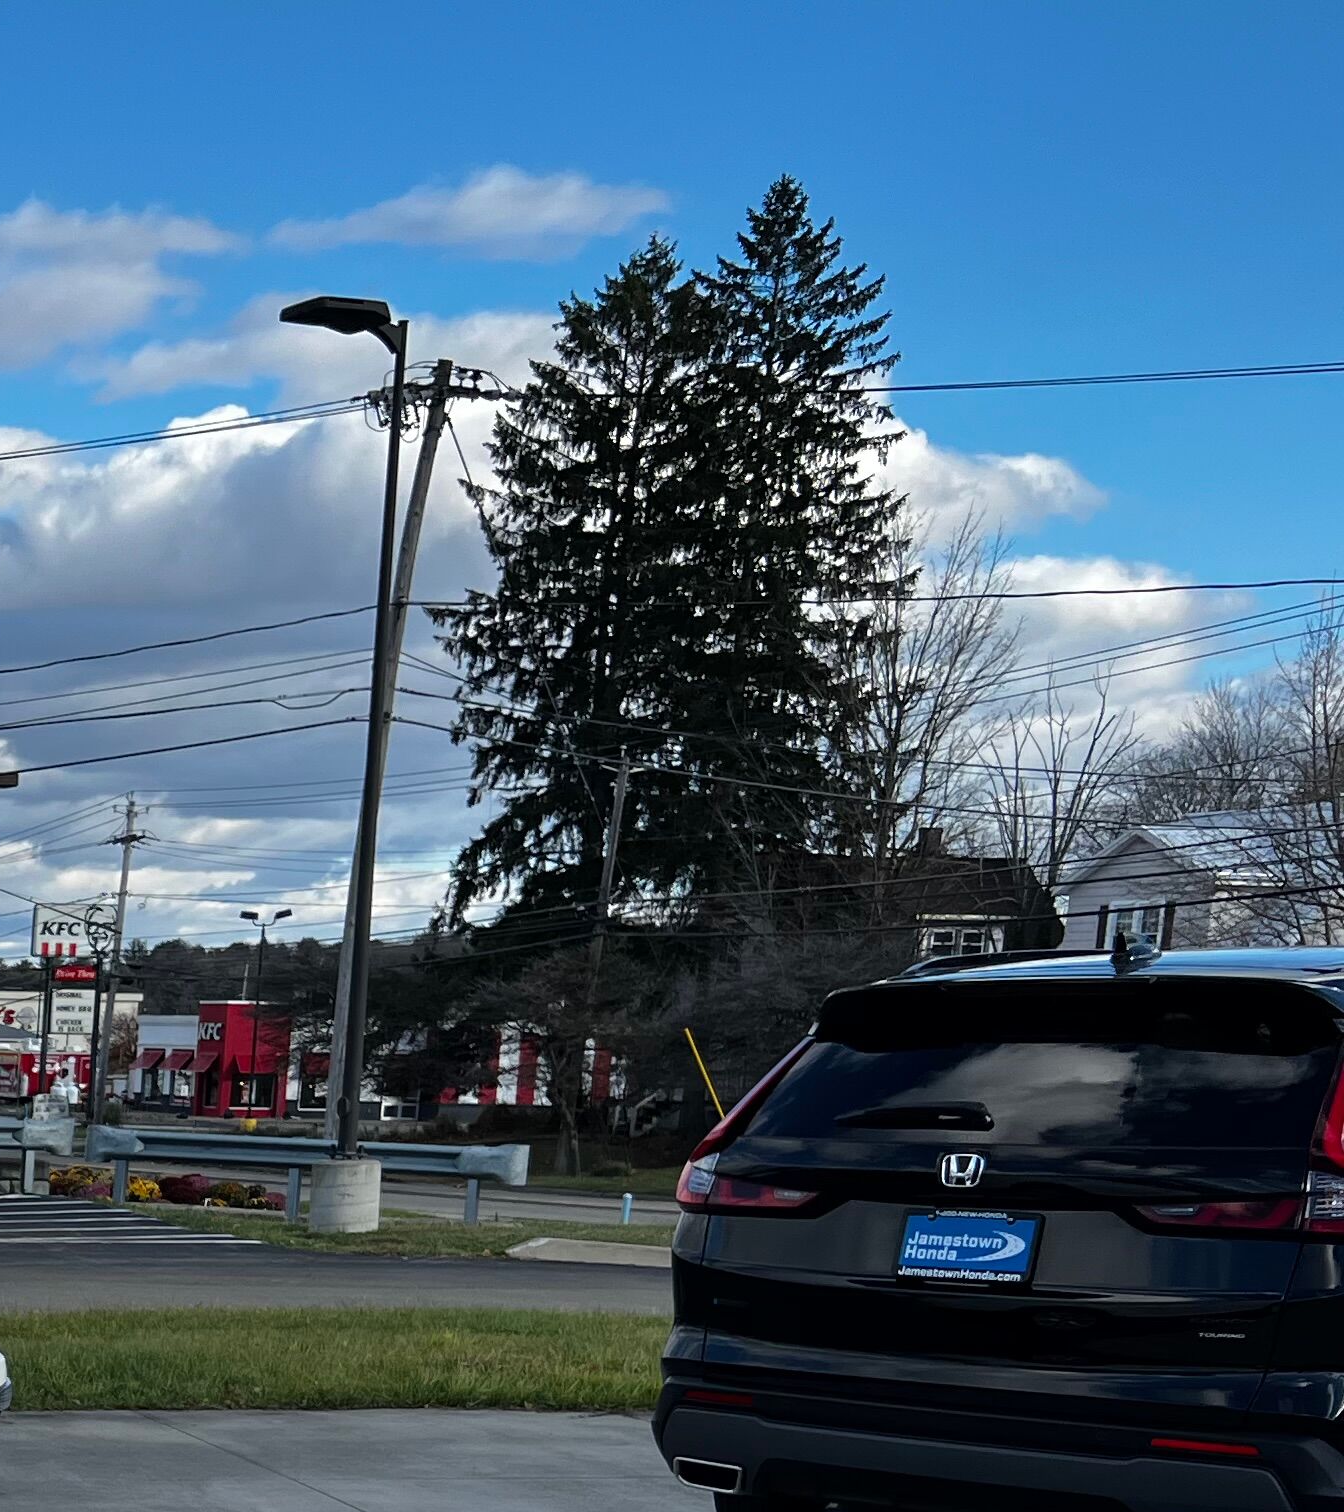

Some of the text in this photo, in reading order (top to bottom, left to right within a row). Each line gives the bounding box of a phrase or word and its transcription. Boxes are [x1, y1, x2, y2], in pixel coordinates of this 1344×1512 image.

[40, 921, 80, 936] KFC
[198, 1022, 222, 1040] KFC
[908, 1231, 1002, 1249] Jamestown
[904, 1244, 957, 1261] Honda
[897, 1265, 1021, 1282] JamestownHonda.com
